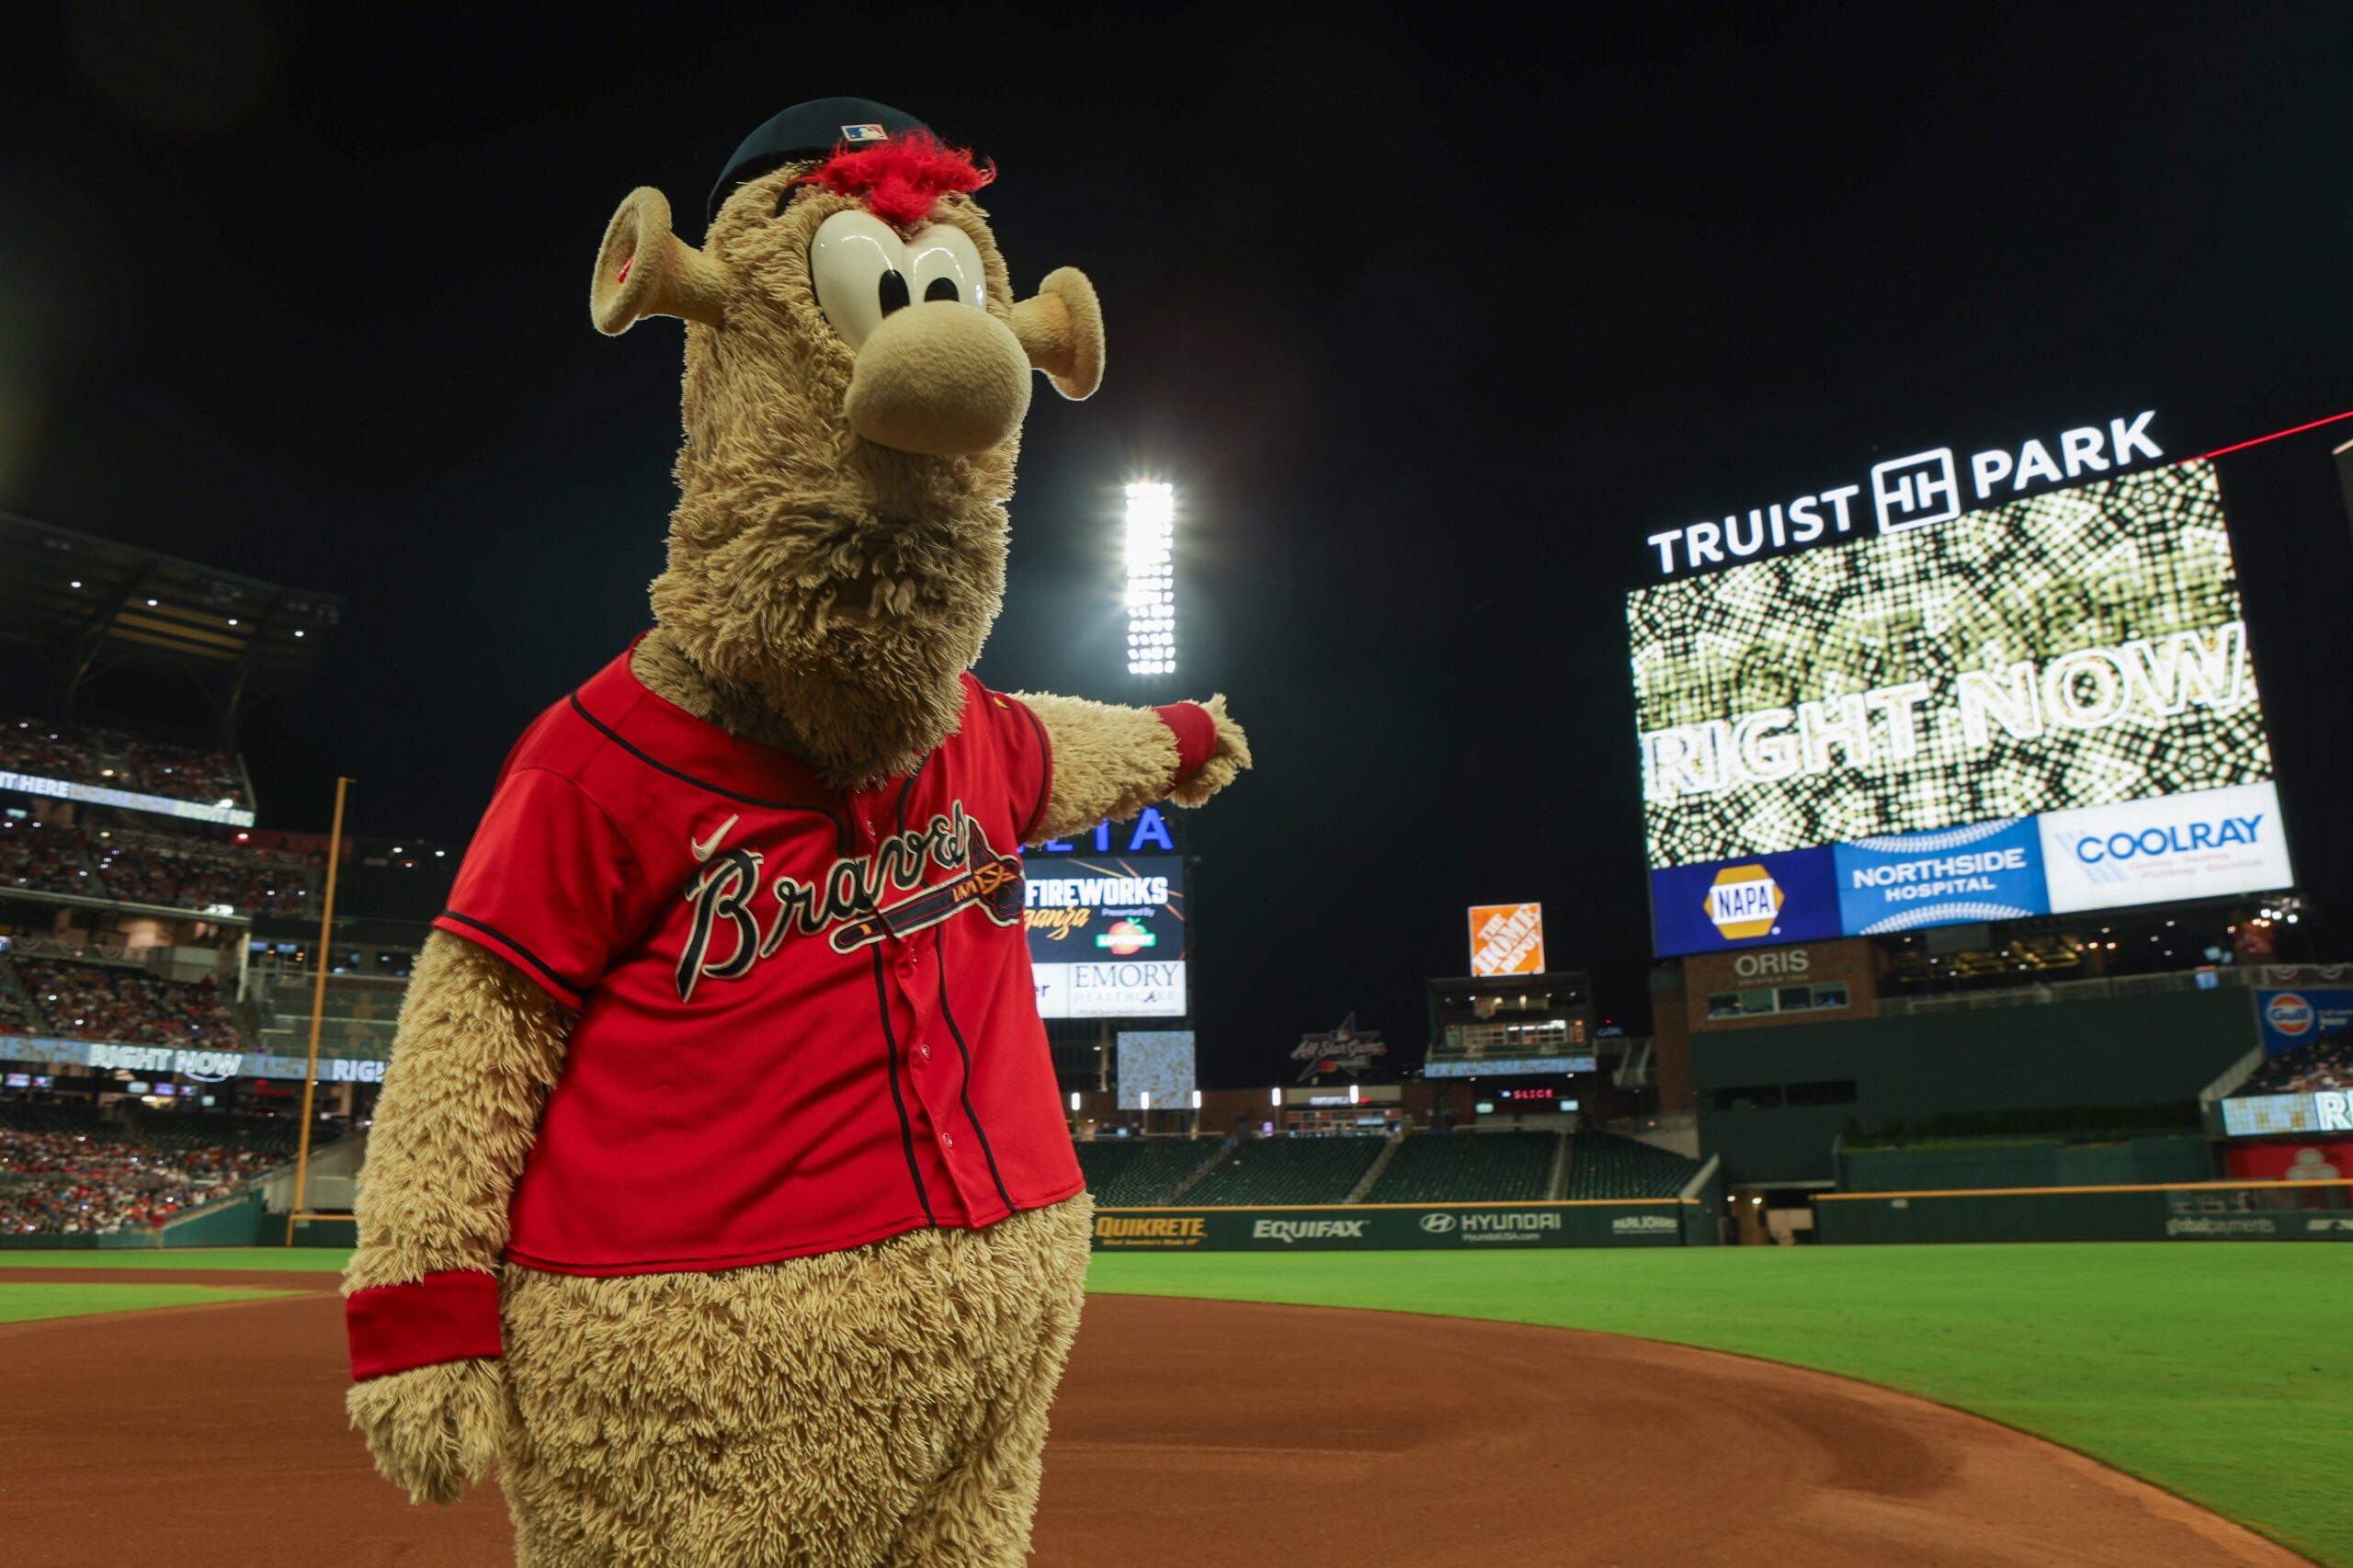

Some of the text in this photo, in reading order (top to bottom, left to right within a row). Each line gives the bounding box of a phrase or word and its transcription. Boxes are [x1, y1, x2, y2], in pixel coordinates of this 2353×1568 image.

[1647, 409, 2165, 574] TRUIST PARK
[1641, 621, 2250, 802] RIGHT NOW
[19, 773, 70, 799] HERE
[2075, 813, 2265, 864] COOLRAY
[1852, 847, 2028, 890] NORTHSIDE
[675, 798, 971, 1006] Braves
[1025, 876, 1169, 907] FIREWORKS
[1717, 884, 1774, 920] NAPA
[1884, 869, 1998, 903] HOSPITAL
[1472, 903, 1543, 976] HOME
[1476, 913, 1507, 942] THE
[1499, 929, 1543, 974] DEPOT
[1734, 949, 1810, 977] ORIS
[1074, 963, 1178, 988] EMORY
[89, 1044, 244, 1078] RIGHT NOW
[1513, 1088, 1554, 1100] SLICE
[1095, 1216, 1205, 1238] QUIKRETE
[1252, 1220, 1364, 1243] EQUIFAX
[1461, 1212, 1562, 1232] HYUNDAI
